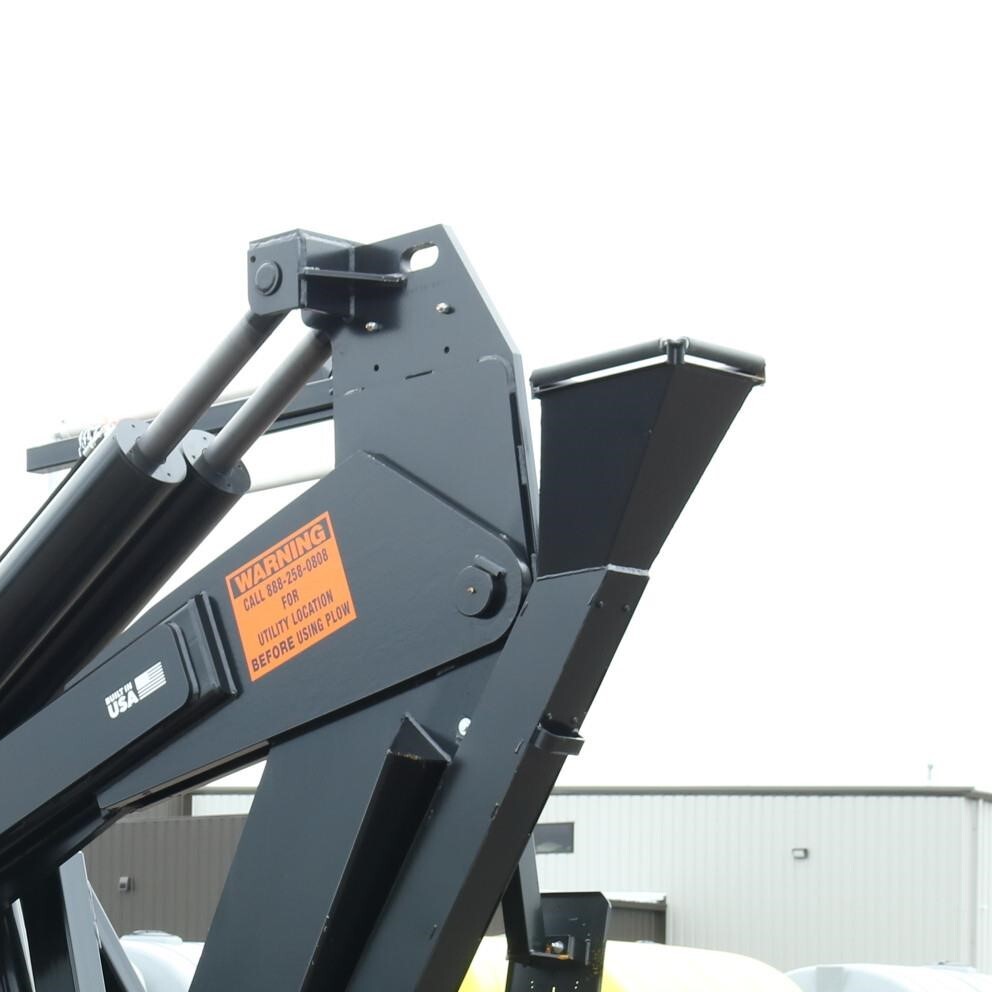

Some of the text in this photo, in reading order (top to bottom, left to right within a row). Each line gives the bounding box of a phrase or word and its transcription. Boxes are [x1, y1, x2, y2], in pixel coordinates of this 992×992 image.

[233, 523, 326, 593] WARNING
[243, 548, 329, 612] CALL 888-258-0808
[257, 589, 334, 646] UTILITY LOCATION
[281, 588, 300, 609] FOR
[251, 601, 352, 672] BEFORE USING PLOW
[107, 690, 139, 718] USA
